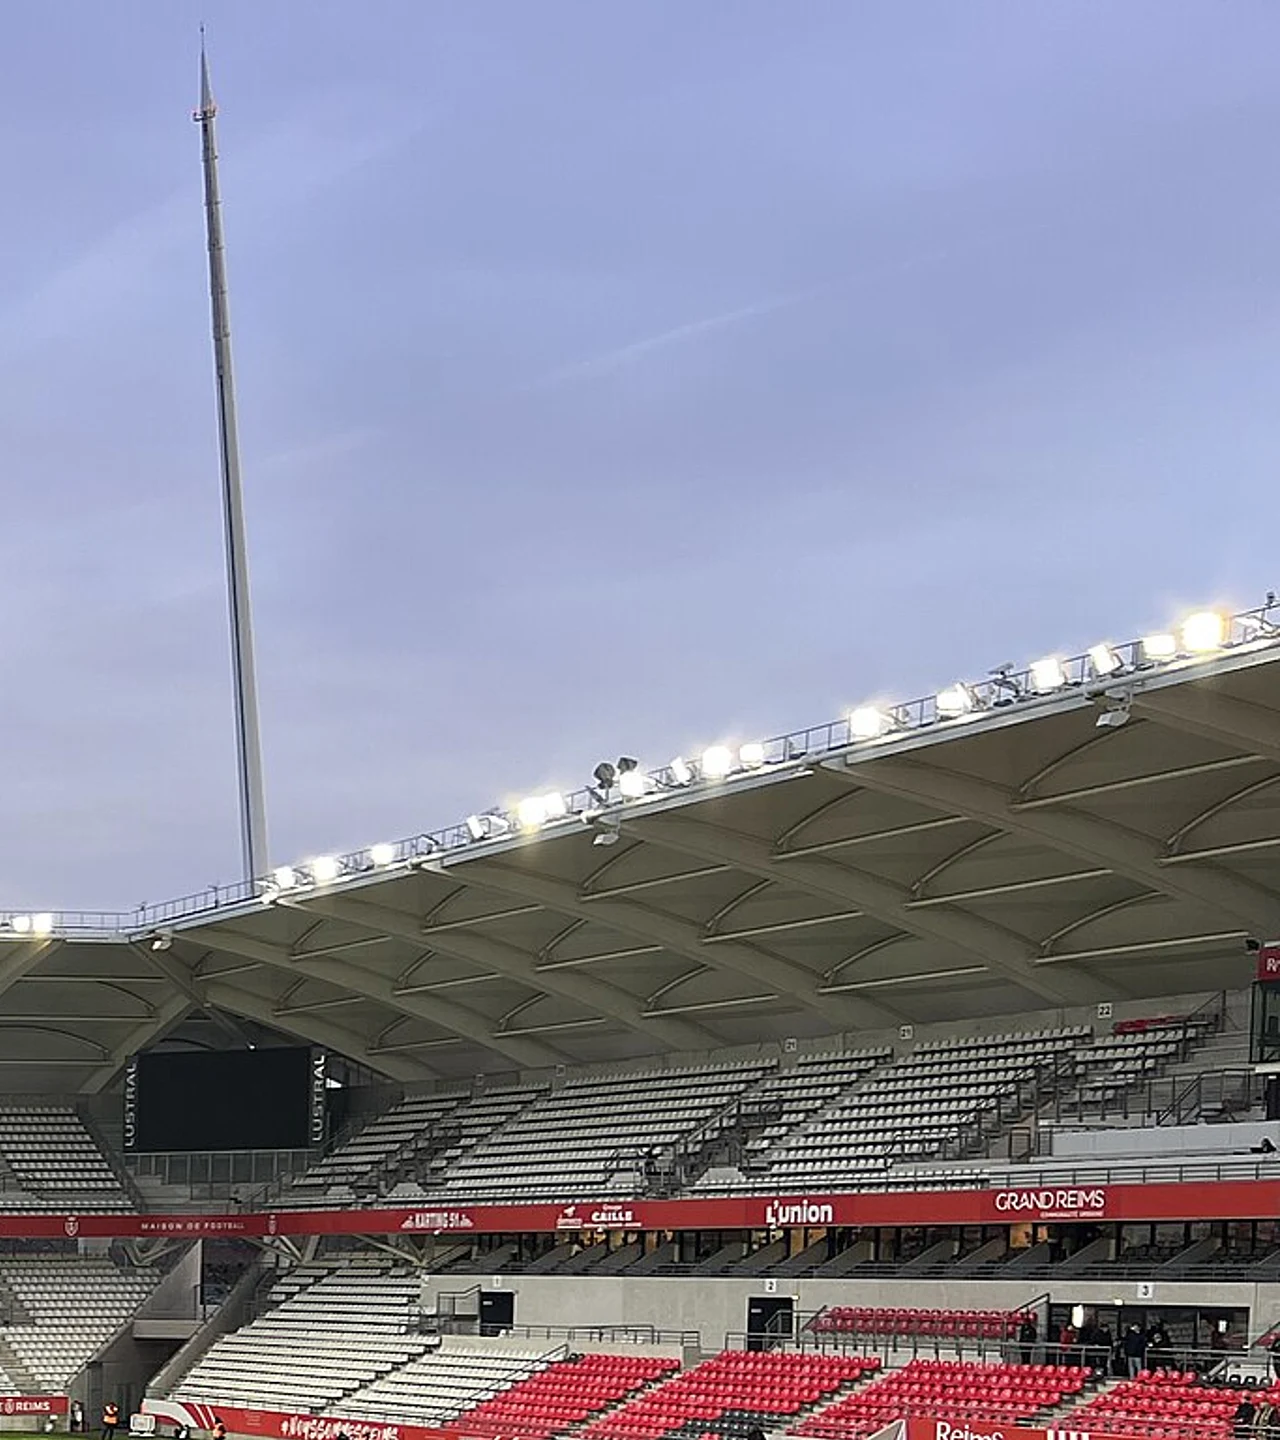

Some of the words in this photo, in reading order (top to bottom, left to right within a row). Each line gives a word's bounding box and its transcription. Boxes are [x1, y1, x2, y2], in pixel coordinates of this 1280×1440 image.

[124, 1063, 137, 1147] LUSTRAL
[312, 1055, 325, 1141] LUSTRAL
[995, 1193, 1054, 1212] GRAND
[1056, 1190, 1104, 1208] REIMS
[592, 1211, 633, 1222] CAILLE
[204, 1222, 245, 1230] FOOTBALL
[15, 1401, 51, 1411] REIMS
